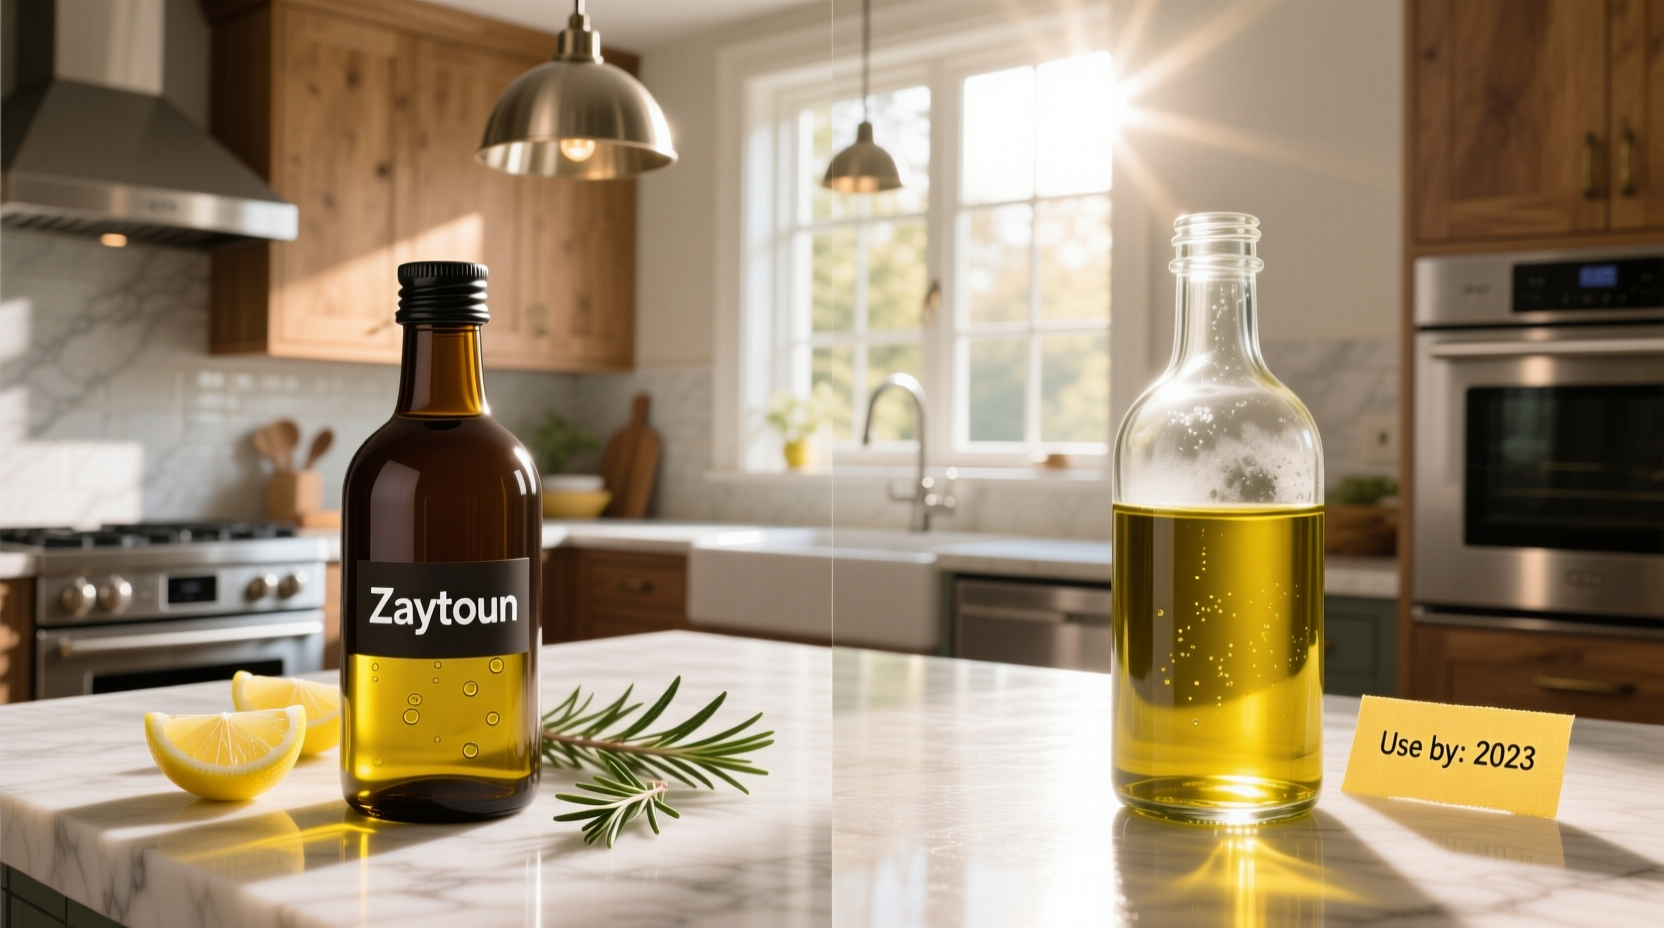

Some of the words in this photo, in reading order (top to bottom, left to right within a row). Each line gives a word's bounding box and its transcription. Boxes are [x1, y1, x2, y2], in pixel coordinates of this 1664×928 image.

[369, 586, 518, 636] Zaytoun
[1380, 730, 1423, 758] Use
[1429, 734, 1466, 769] by:
[1473, 740, 1536, 771] 2023
